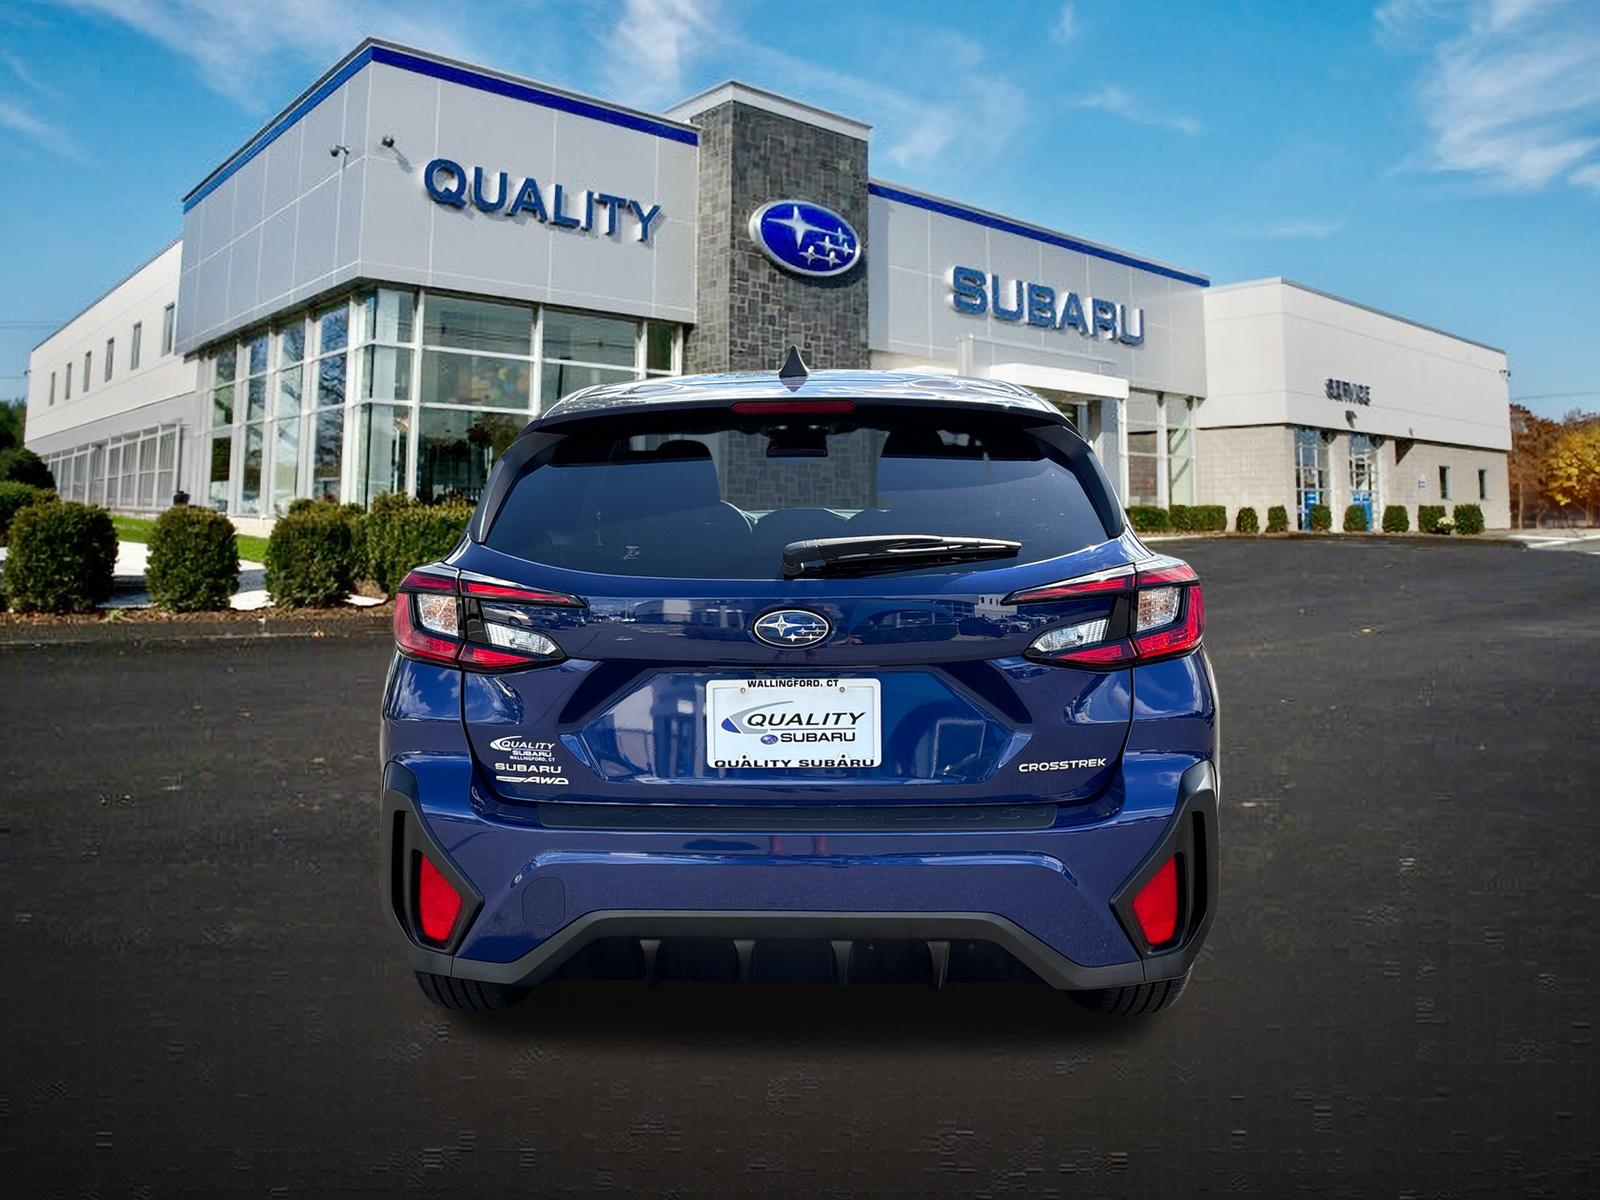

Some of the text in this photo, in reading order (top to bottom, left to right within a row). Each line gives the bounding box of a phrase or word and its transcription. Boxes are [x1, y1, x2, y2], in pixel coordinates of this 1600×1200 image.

[424, 158, 661, 242] QUALITY
[951, 265, 1144, 346] SUBARU
[1325, 378, 1370, 406] SERVICE
[826, 679, 839, 687] CT
[747, 712, 865, 726] QUALITY
[780, 732, 856, 743] SUBARU
[502, 741, 555, 749] QUALITY
[495, 763, 561, 773] SUBARU
[714, 759, 875, 768] QUALITY SUBARU
[1019, 758, 1106, 772] CROSSTREK
